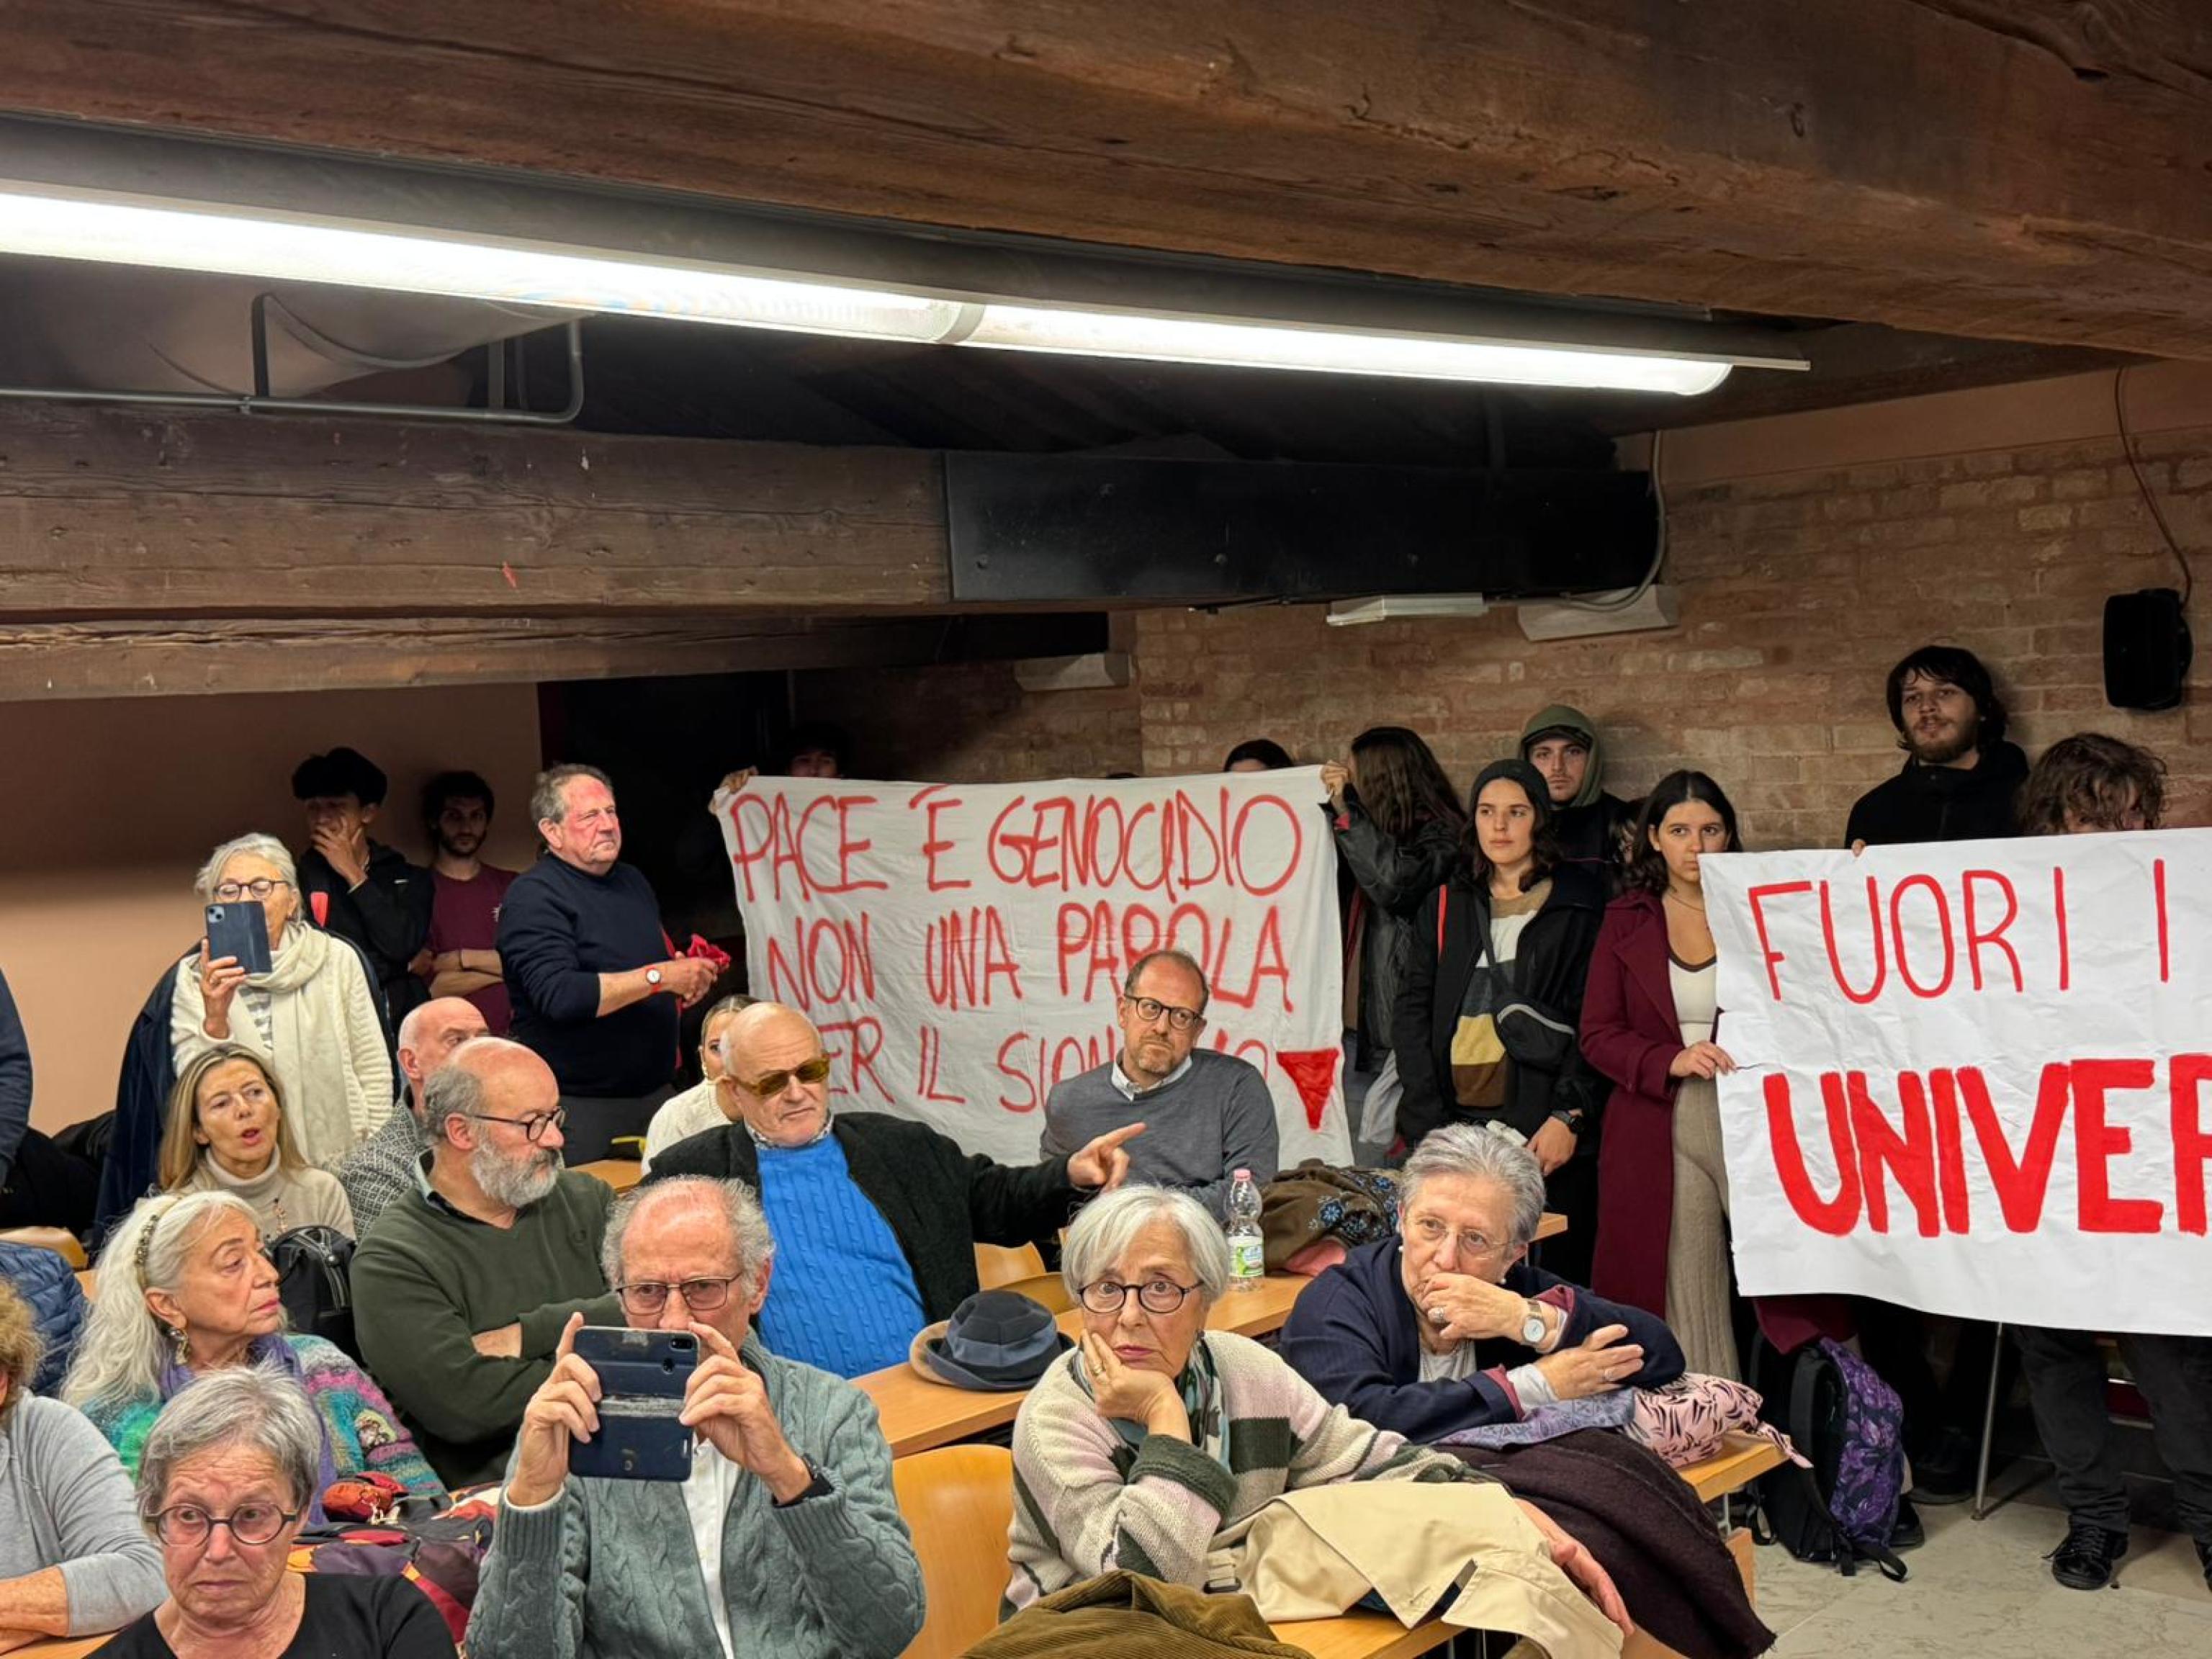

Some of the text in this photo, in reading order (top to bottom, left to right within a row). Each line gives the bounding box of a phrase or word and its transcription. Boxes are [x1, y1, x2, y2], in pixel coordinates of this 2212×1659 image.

[729, 793, 888, 902] PACE
[988, 788, 1303, 904] GENOCIDIO
[768, 900, 1294, 1013] NON UNA PAROLA
[1748, 867, 2069, 1004] FUORI
[818, 1017, 895, 1105] ER
[917, 1026, 966, 1105] IL
